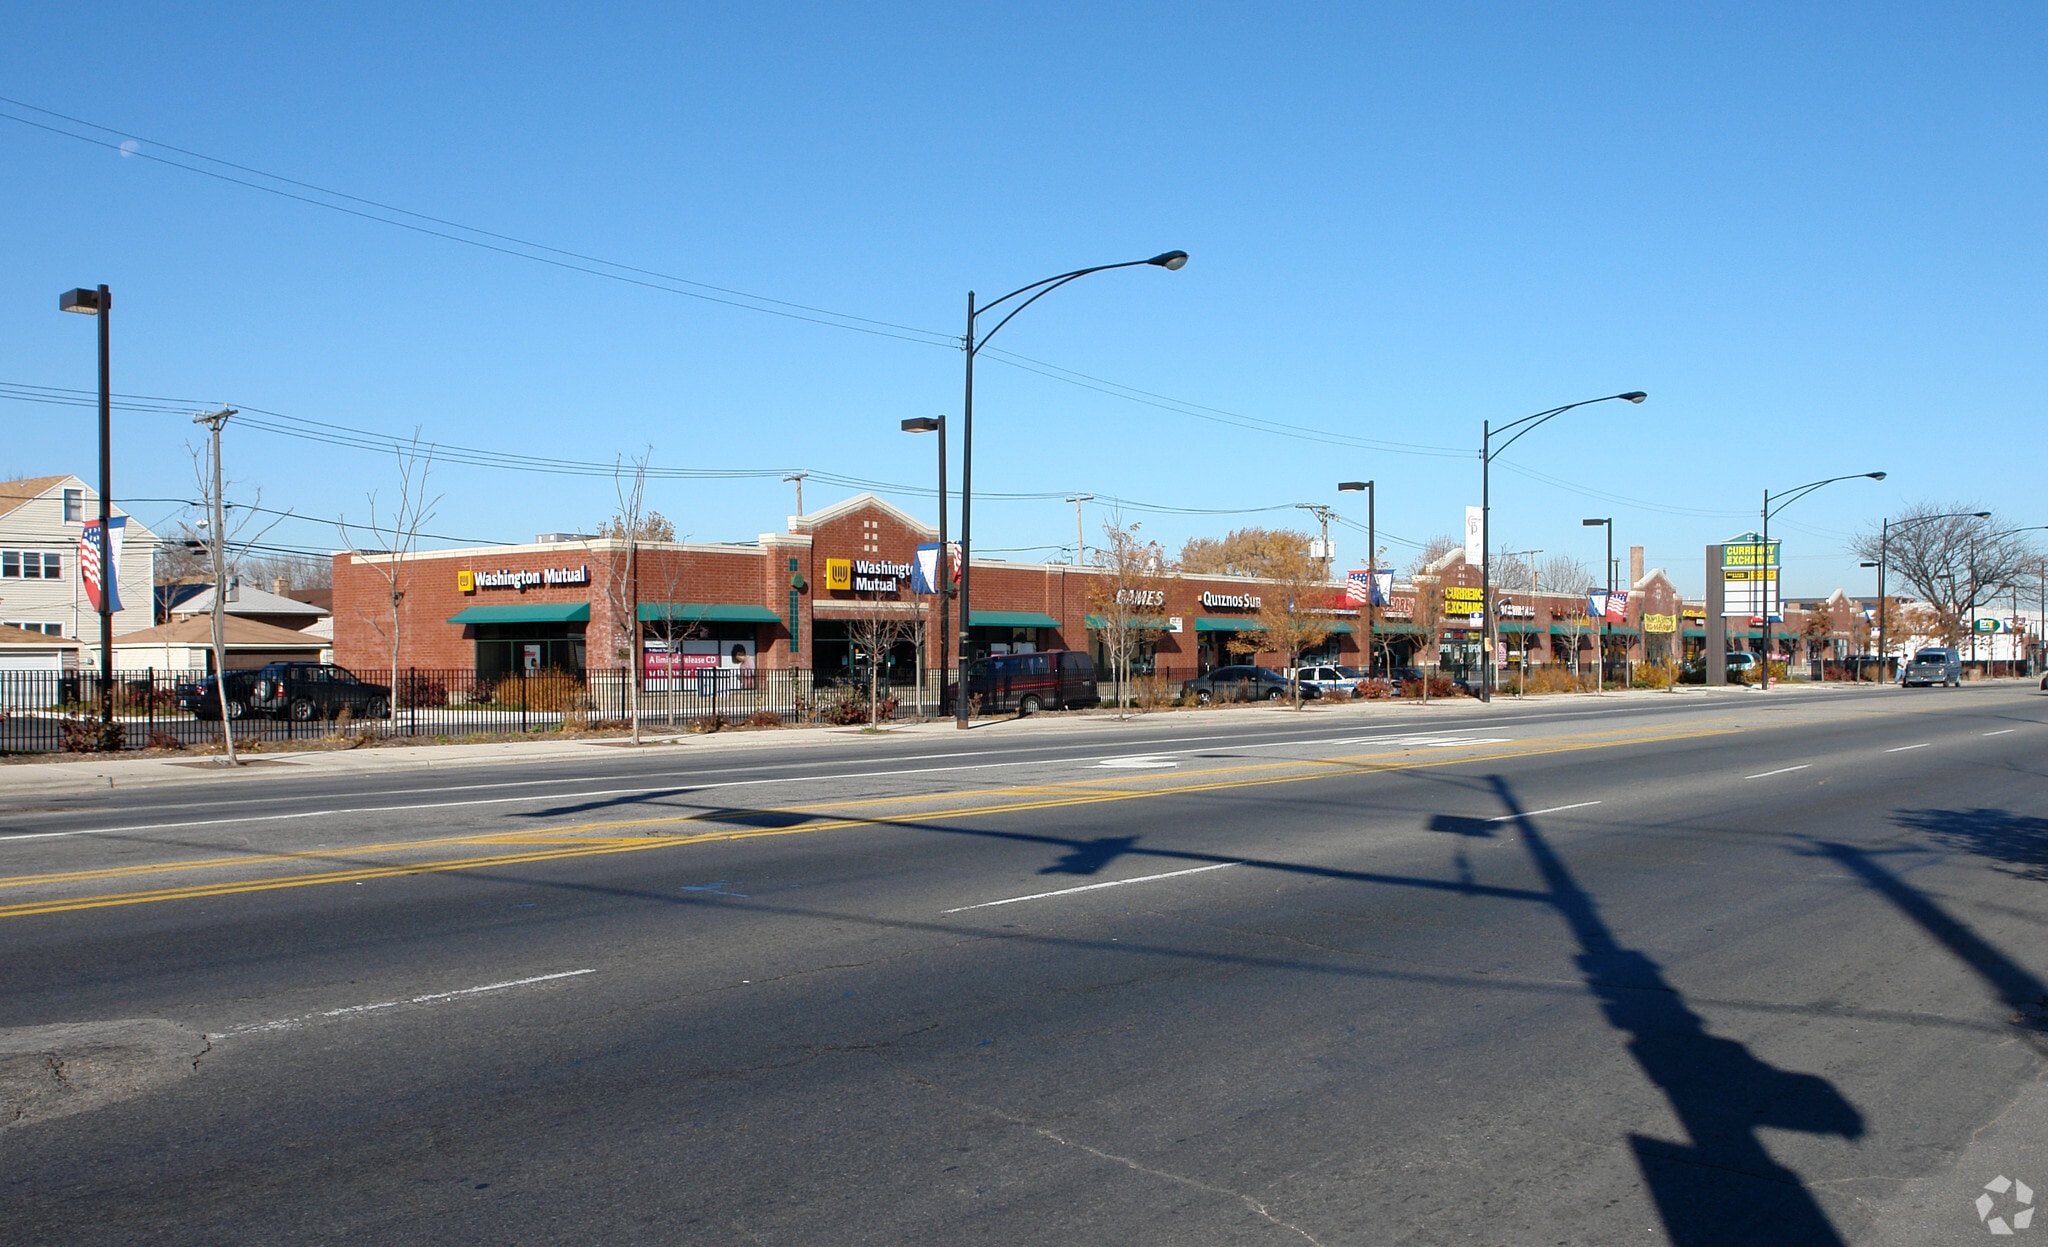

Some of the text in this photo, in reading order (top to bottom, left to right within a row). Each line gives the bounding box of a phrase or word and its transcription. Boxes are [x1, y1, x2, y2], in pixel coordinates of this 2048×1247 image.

[1727, 545, 1774, 555] CURRENY
[1727, 555, 1774, 565] EXCHANE
[474, 565, 586, 588] Washington Mutual
[856, 560, 913, 579] Washingt
[856, 577, 897, 592] Mutual
[1445, 586, 1484, 601] CURRENC
[1445, 600, 1484, 614] EXCHANG
[706, 655, 716, 664] CD
